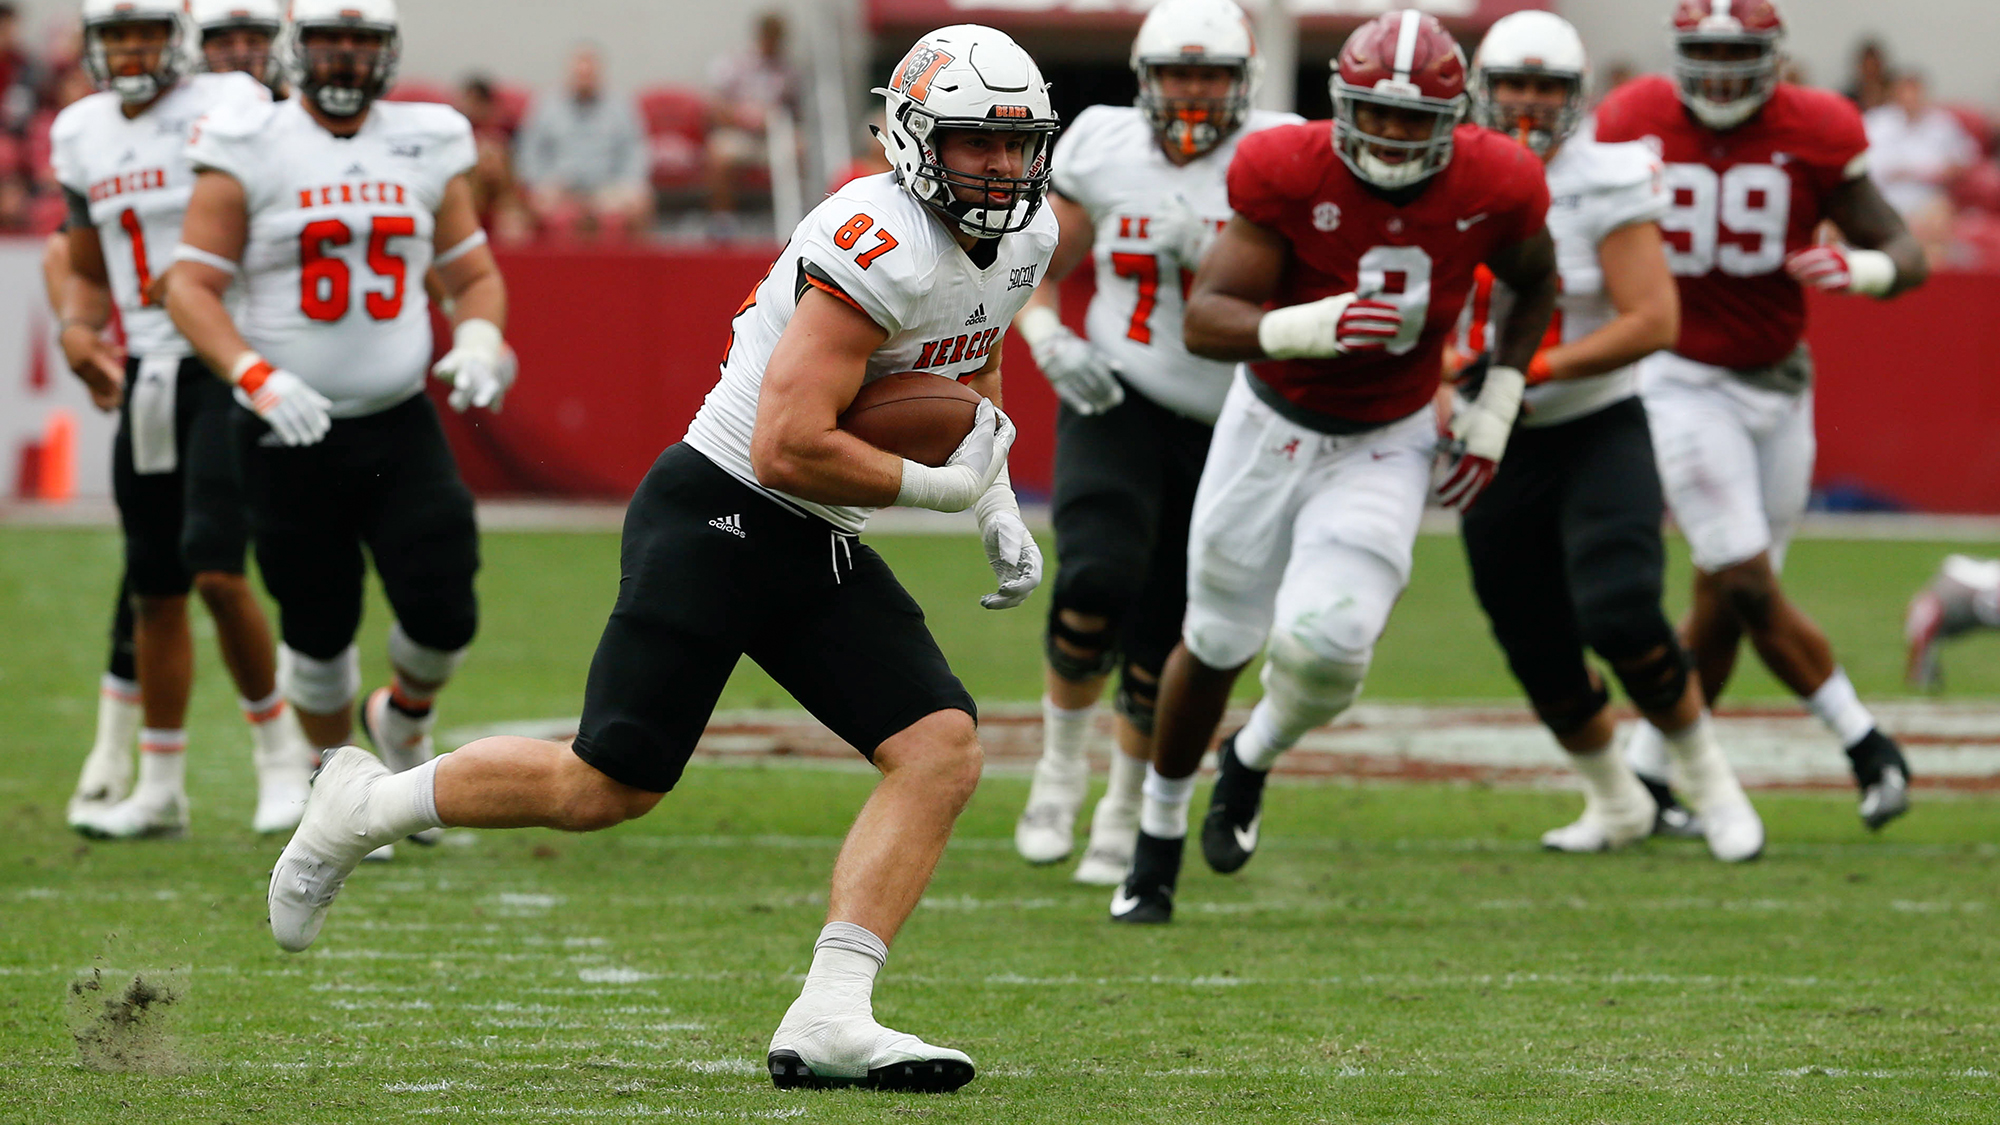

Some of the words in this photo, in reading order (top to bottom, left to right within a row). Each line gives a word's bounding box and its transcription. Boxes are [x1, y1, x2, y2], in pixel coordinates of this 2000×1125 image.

[995, 105, 1027, 118] BEARS
[120, 207, 150, 307] 1
[833, 212, 899, 271] 87
[1661, 162, 1791, 277] 99
[299, 215, 416, 323] 65
[709, 519, 746, 538] adidas
